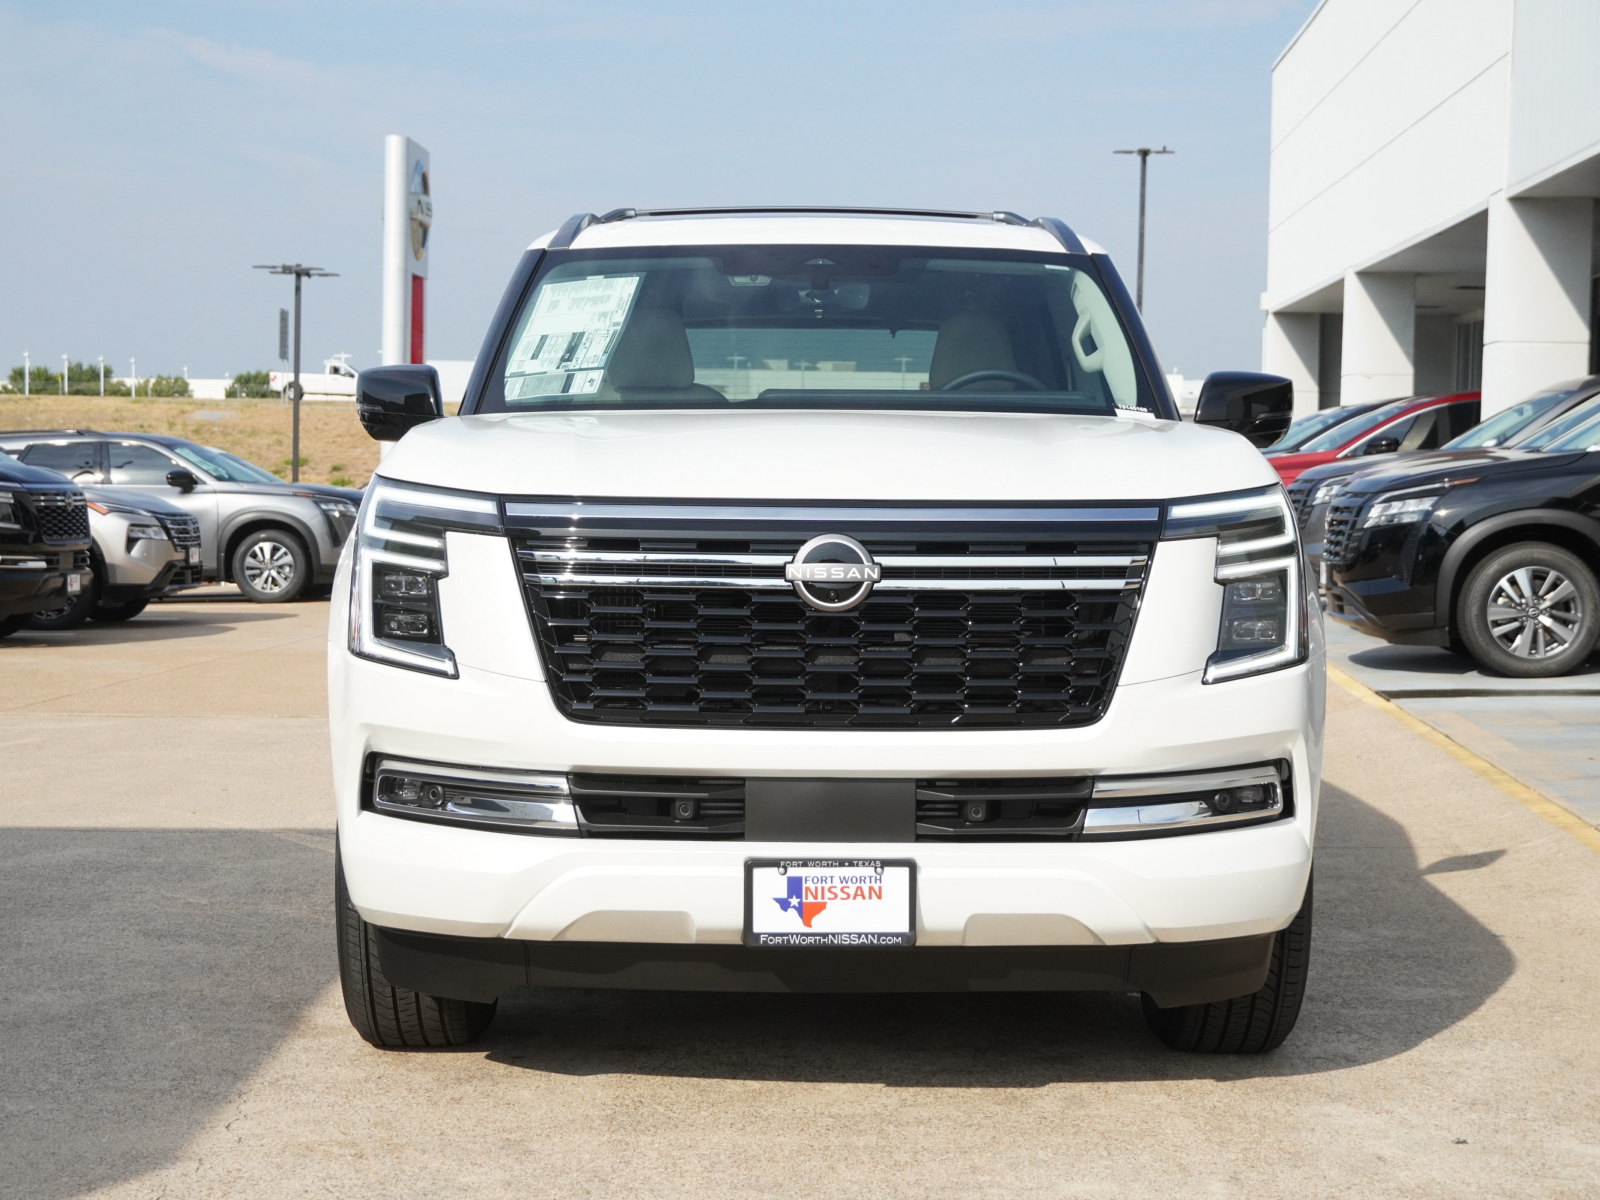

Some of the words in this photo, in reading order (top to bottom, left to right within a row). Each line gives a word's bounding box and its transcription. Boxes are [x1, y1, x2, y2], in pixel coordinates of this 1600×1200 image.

[788, 567, 878, 579] NISSAN
[804, 875, 835, 884] FORT
[839, 875, 882, 884] WORTH
[804, 885, 883, 900] NISSAN
